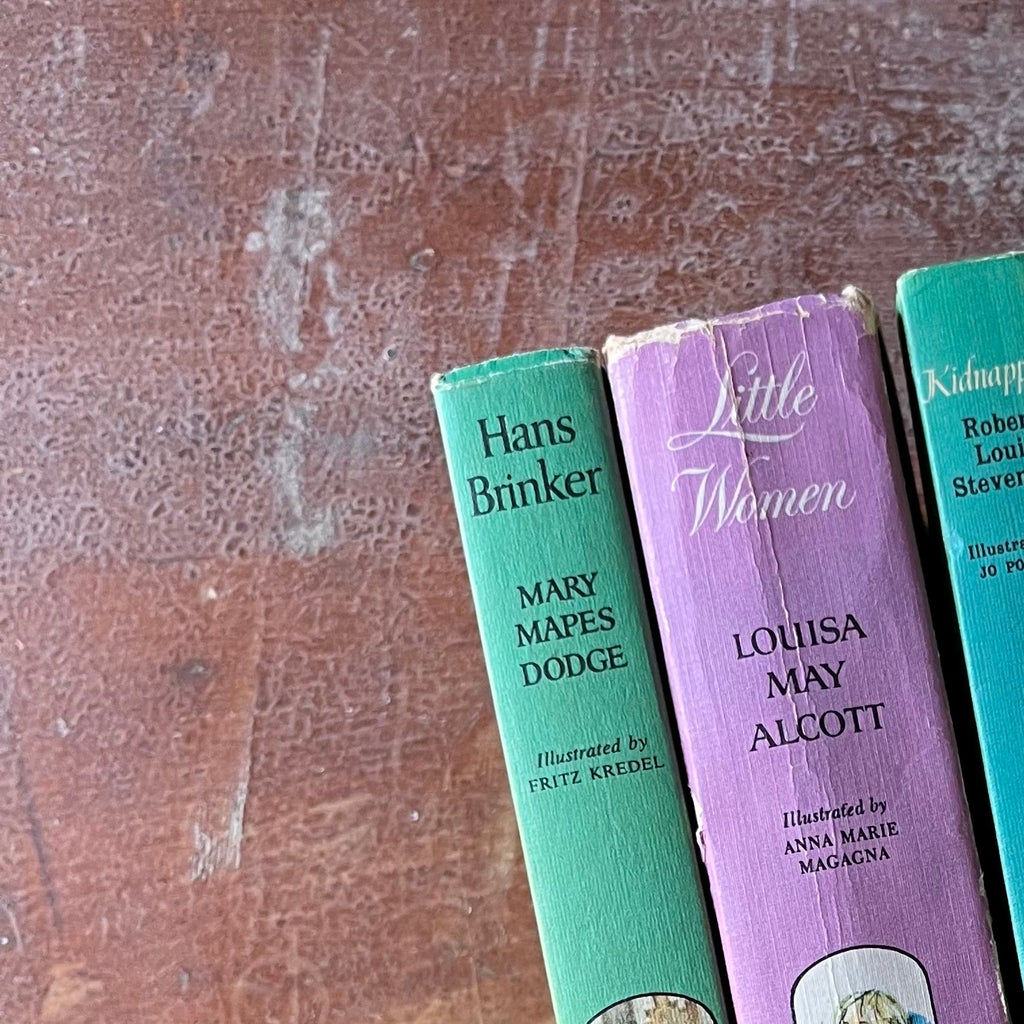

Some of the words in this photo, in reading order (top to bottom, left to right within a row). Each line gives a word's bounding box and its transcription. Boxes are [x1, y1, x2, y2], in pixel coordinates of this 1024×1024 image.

[667, 350, 818, 451] Little
[478, 414, 576, 458] Hans
[467, 458, 602, 517] Brinker
[671, 456, 856, 536] Women
[517, 572, 598, 609] MARY
[980, 564, 997, 578] JO
[515, 607, 615, 648] MAPES
[733, 614, 867, 660] LOUISA
[520, 645, 628, 687] DODGE
[766, 660, 846, 698] MAY
[750, 703, 885, 752] ALCOTT
[537, 738, 622, 769] Illustrated
[628, 735, 648, 752] by
[529, 770, 582, 793] FRITZ
[590, 755, 664, 780] KREDEL
[783, 799, 865, 828] Illustrated
[870, 797, 887, 815] by
[784, 829, 835, 855] ANNA
[841, 820, 899, 844] MARIE
[799, 846, 890, 874] MAGAGNA
